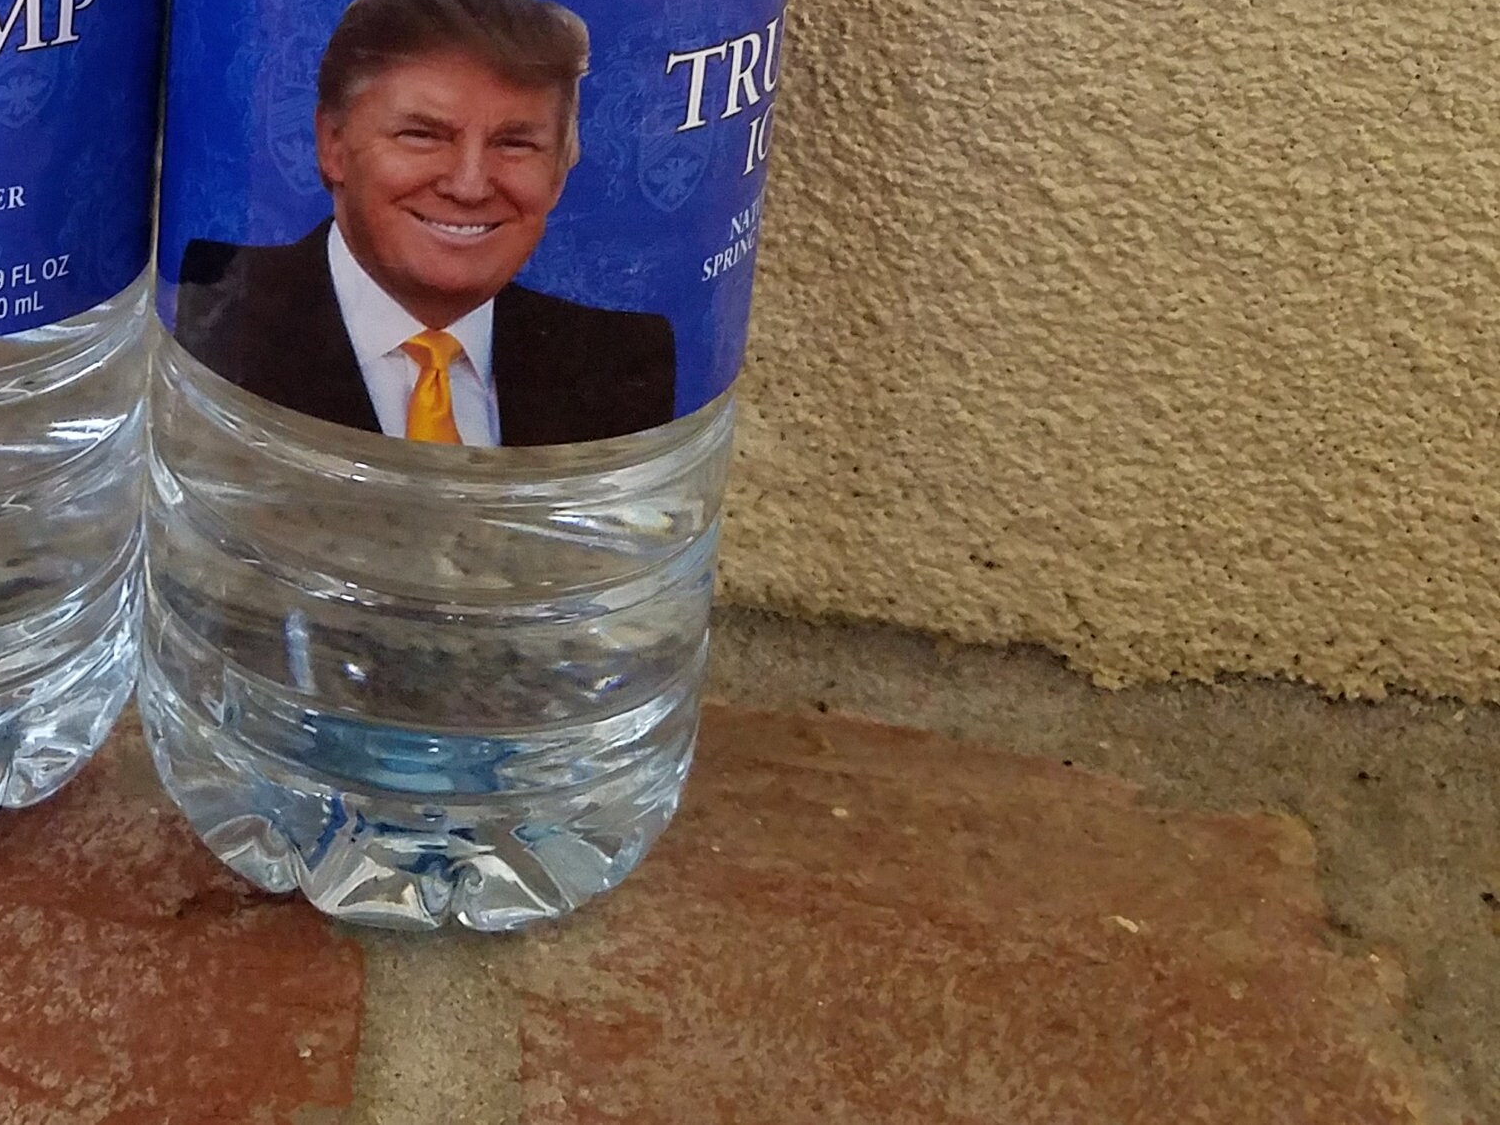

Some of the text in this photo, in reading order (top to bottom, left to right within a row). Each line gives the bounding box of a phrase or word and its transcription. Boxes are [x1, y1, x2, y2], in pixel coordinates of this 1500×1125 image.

[666, 6, 787, 133] TRU
[743, 102, 775, 175] IC
[11, 264, 36, 288] FL
[42, 254, 70, 281] OZ
[14, 291, 43, 317] mL
